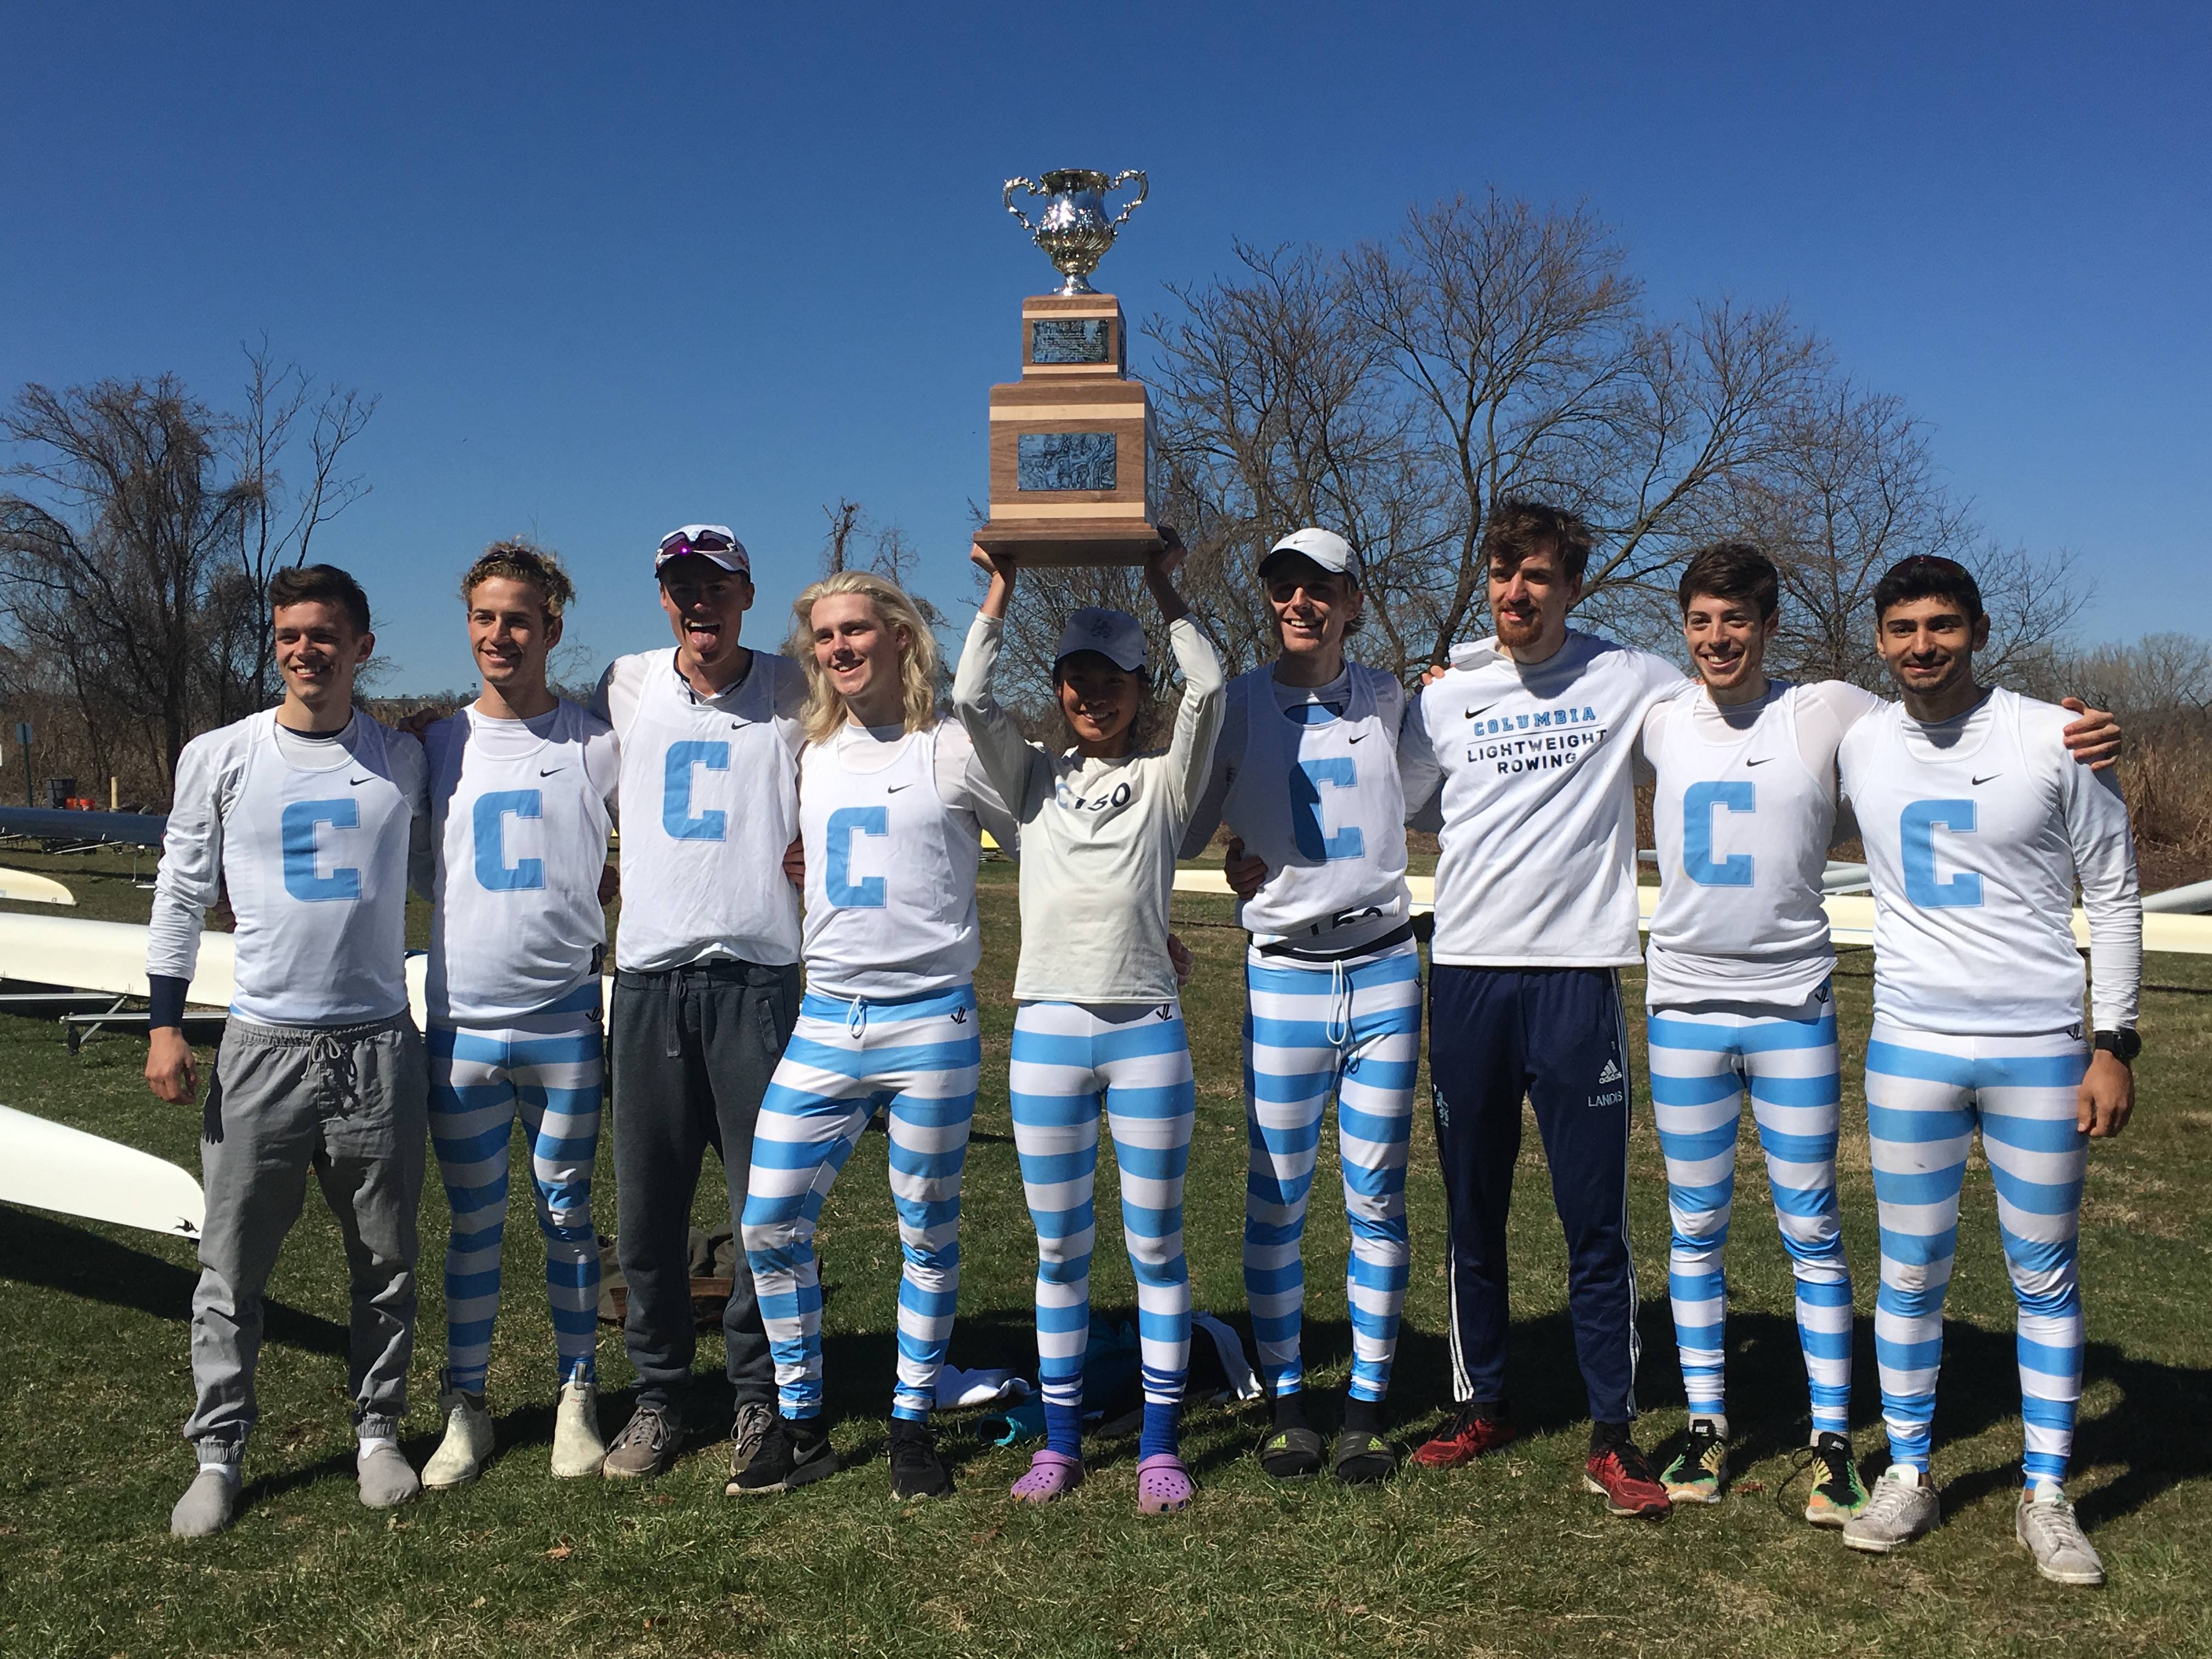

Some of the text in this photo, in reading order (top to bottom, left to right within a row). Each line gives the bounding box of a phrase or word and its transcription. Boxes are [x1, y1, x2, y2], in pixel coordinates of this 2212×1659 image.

[1466, 729, 1607, 763] LIGHTWEIGHT
[1474, 706, 1596, 736] COLUMBIA
[1497, 753, 1577, 775] ROWING
[473, 789, 545, 891] C
[663, 741, 731, 842] C
[1056, 782, 1131, 811] C150
[1289, 757, 1364, 862] C
[1684, 781, 1754, 887] C
[281, 799, 362, 902] C
[826, 806, 888, 909] C
[1900, 799, 1984, 909] C
[1588, 1090, 1623, 1107] LANDIS
